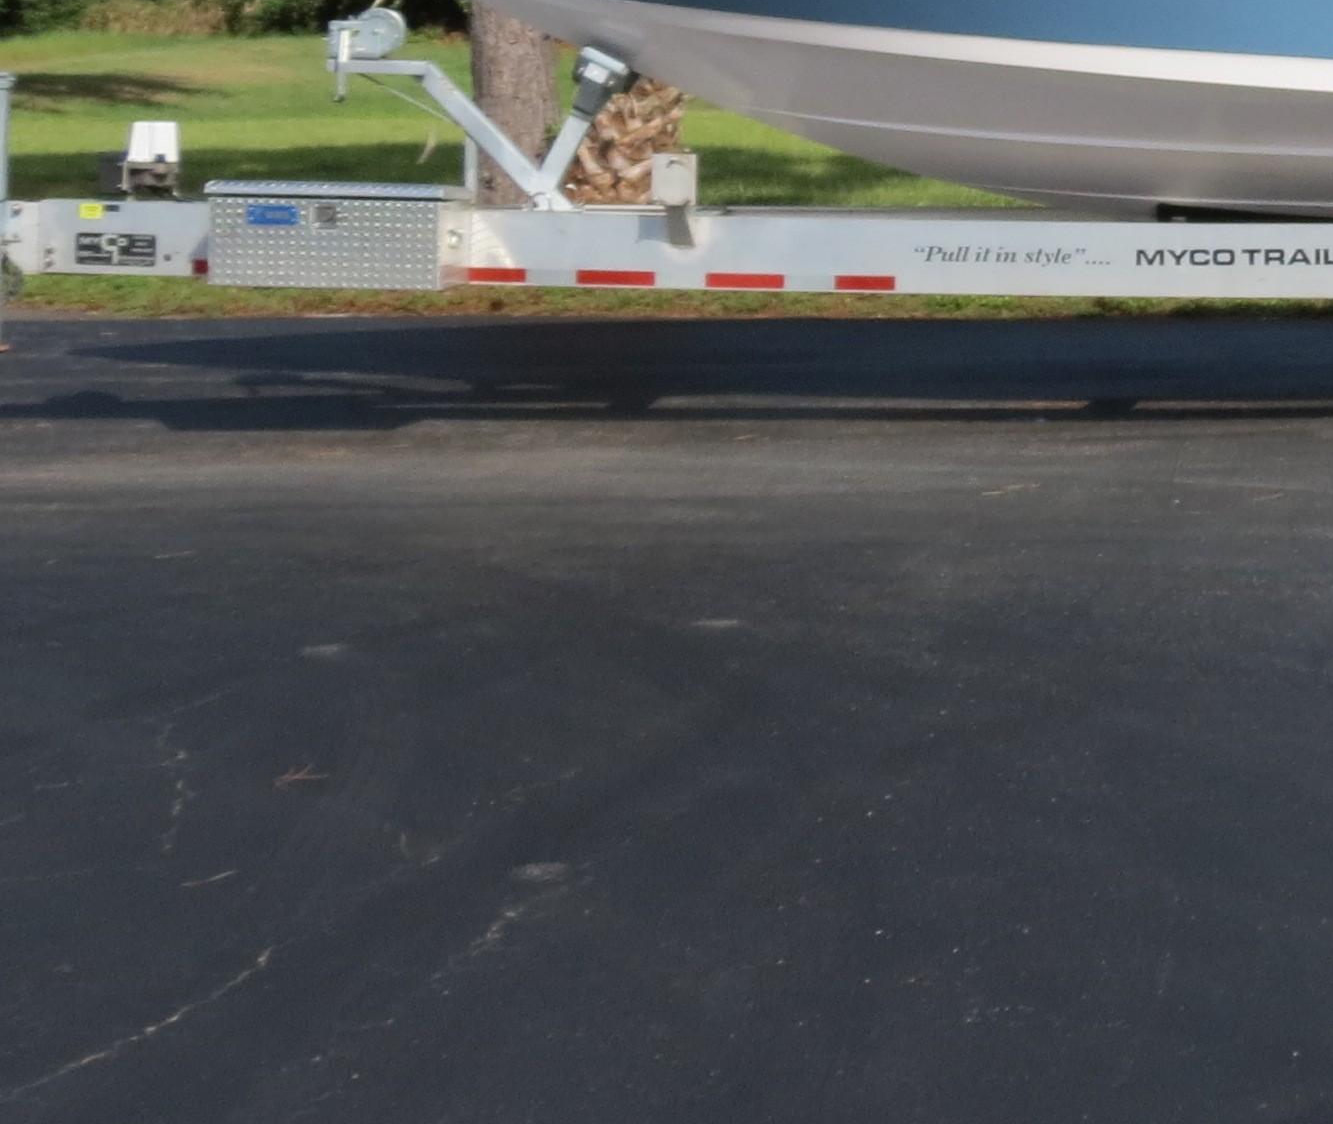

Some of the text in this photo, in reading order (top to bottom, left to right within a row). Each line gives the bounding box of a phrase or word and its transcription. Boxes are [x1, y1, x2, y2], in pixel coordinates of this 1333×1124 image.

[974, 246, 991, 263] it
[995, 246, 1017, 263] in
[1135, 249, 1235, 266] MYCO
